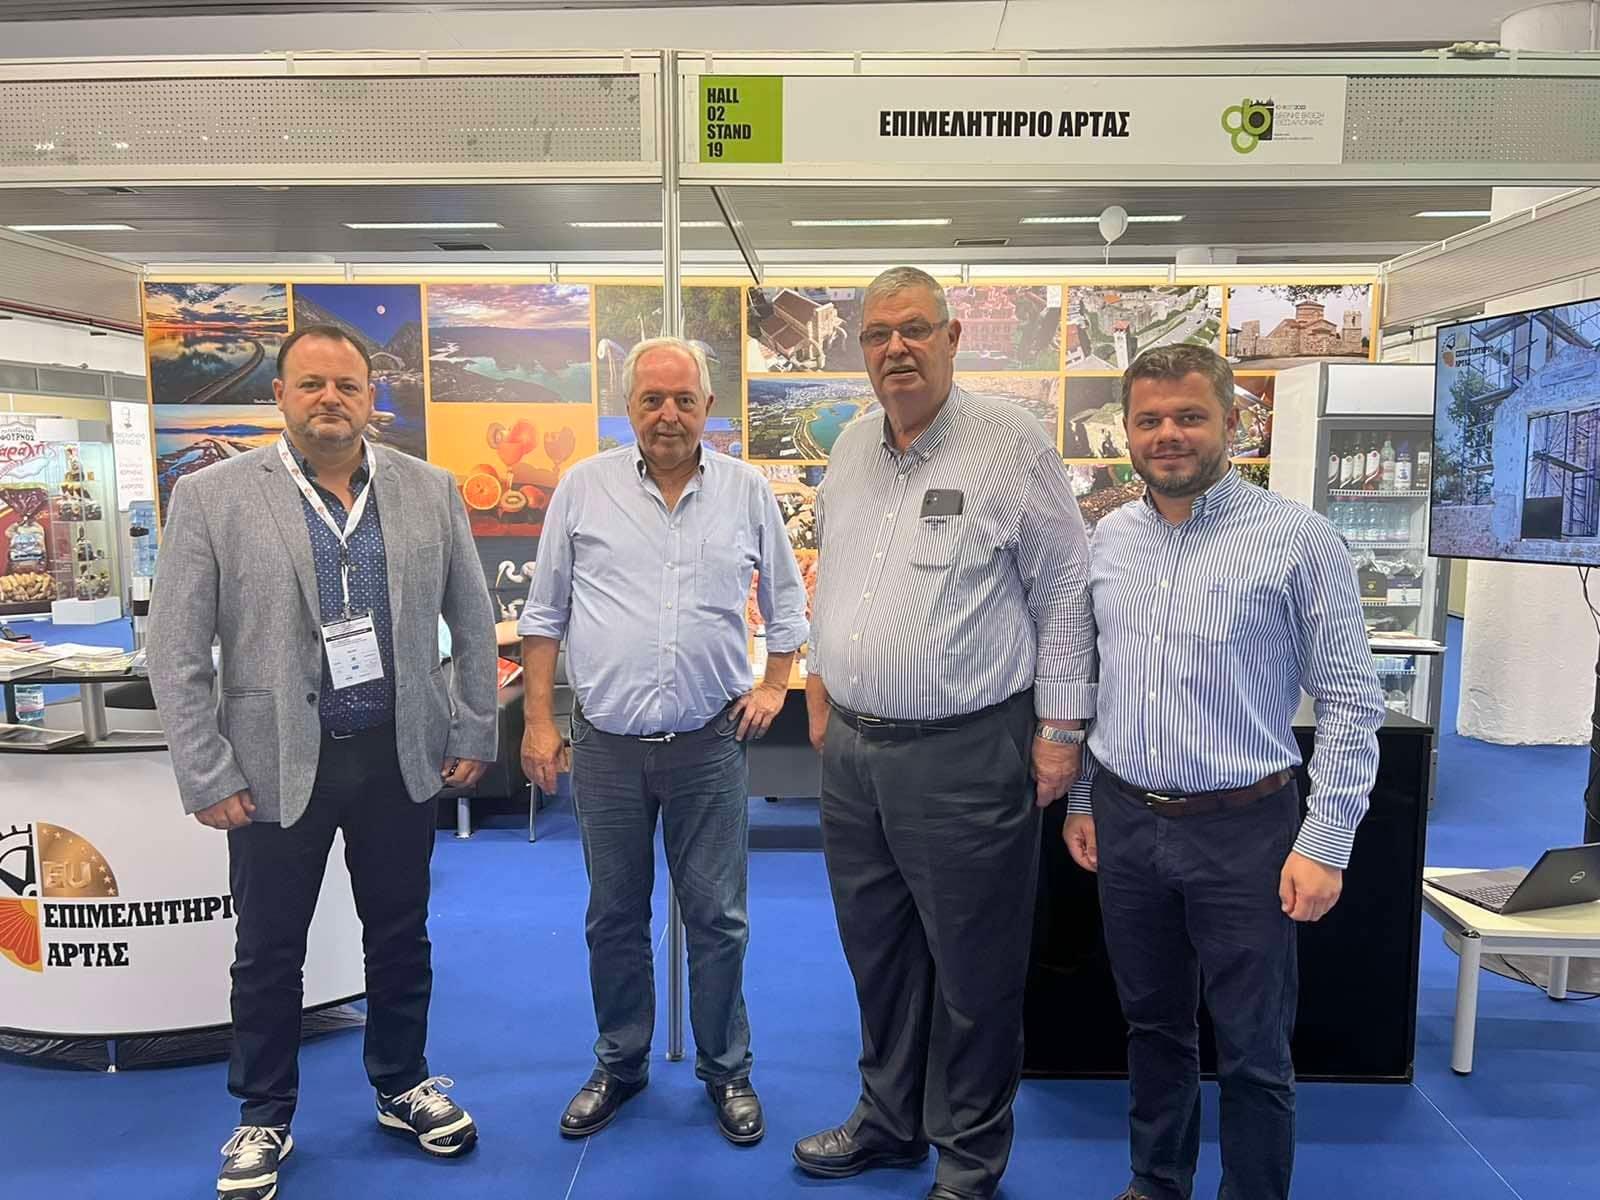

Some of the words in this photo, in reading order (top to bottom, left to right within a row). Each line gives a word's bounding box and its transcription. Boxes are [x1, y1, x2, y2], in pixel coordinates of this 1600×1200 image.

[707, 87, 740, 104] HALL
[707, 105, 725, 122] 02
[879, 110, 1053, 138] ΕΠΙΜΕΛΗΤΗΡΙΟ
[1058, 110, 1131, 138] ΑΡΤΑΣ
[707, 124, 752, 140] STAND
[706, 141, 724, 158] 19
[42, 861, 92, 889] EU
[43, 895, 233, 929] ΕΠΙΜΕΛΗΤΗΡΙ
[47, 942, 130, 967] ΑΡΤΑΣ
